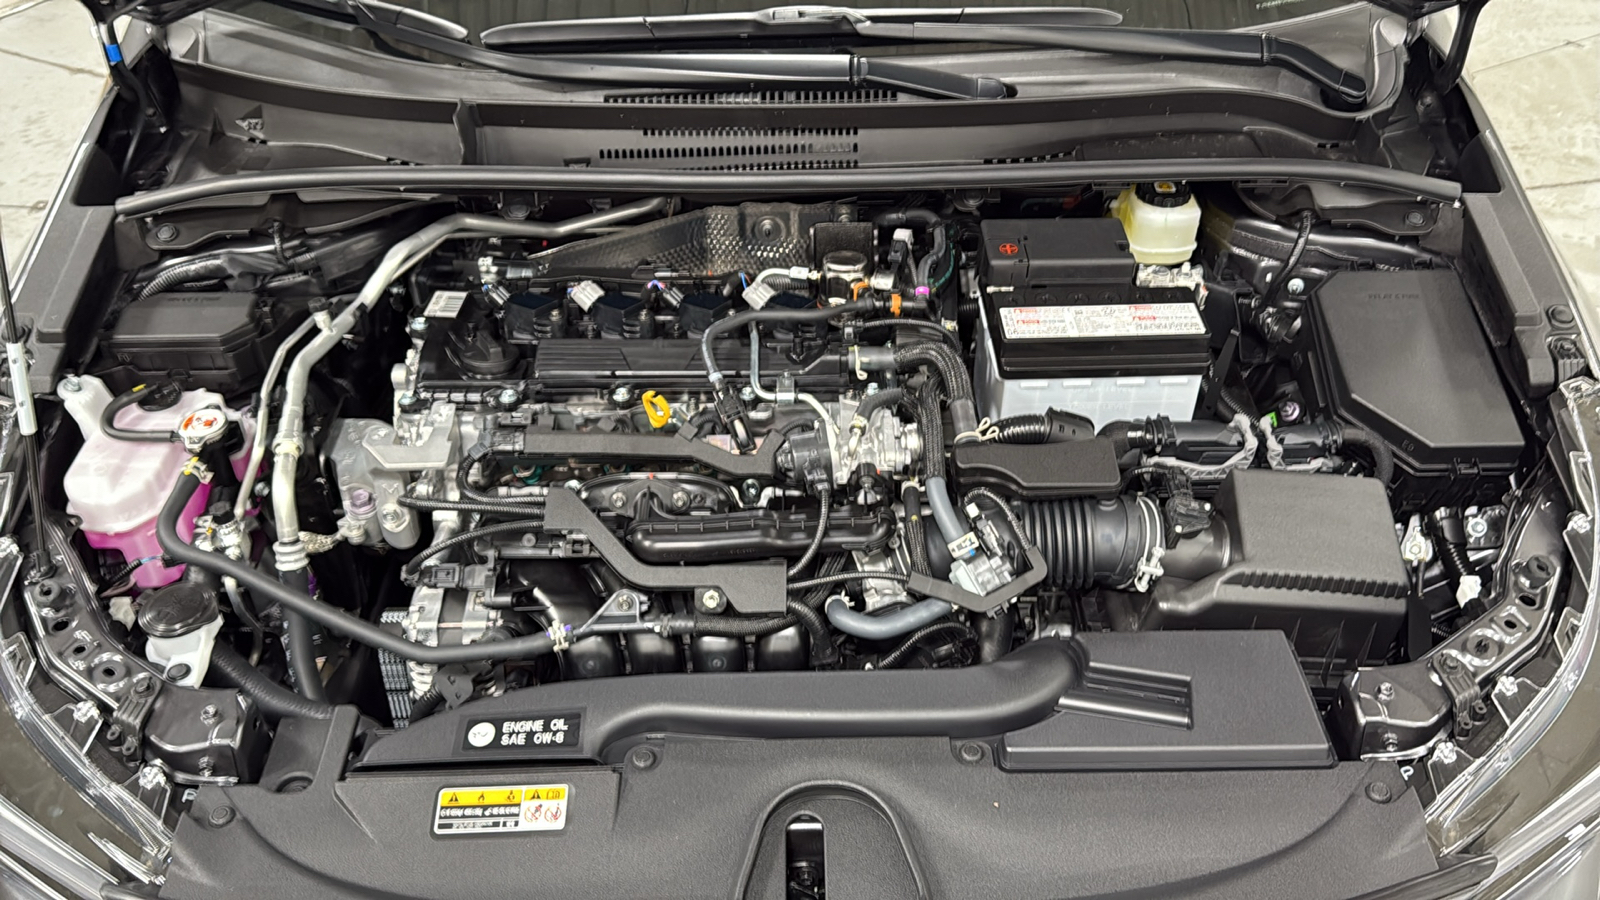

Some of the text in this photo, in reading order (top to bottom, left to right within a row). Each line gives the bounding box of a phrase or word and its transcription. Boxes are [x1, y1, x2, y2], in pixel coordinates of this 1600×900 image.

[502, 717, 569, 734] ENGINE OIL
[500, 733, 527, 746] SAE
